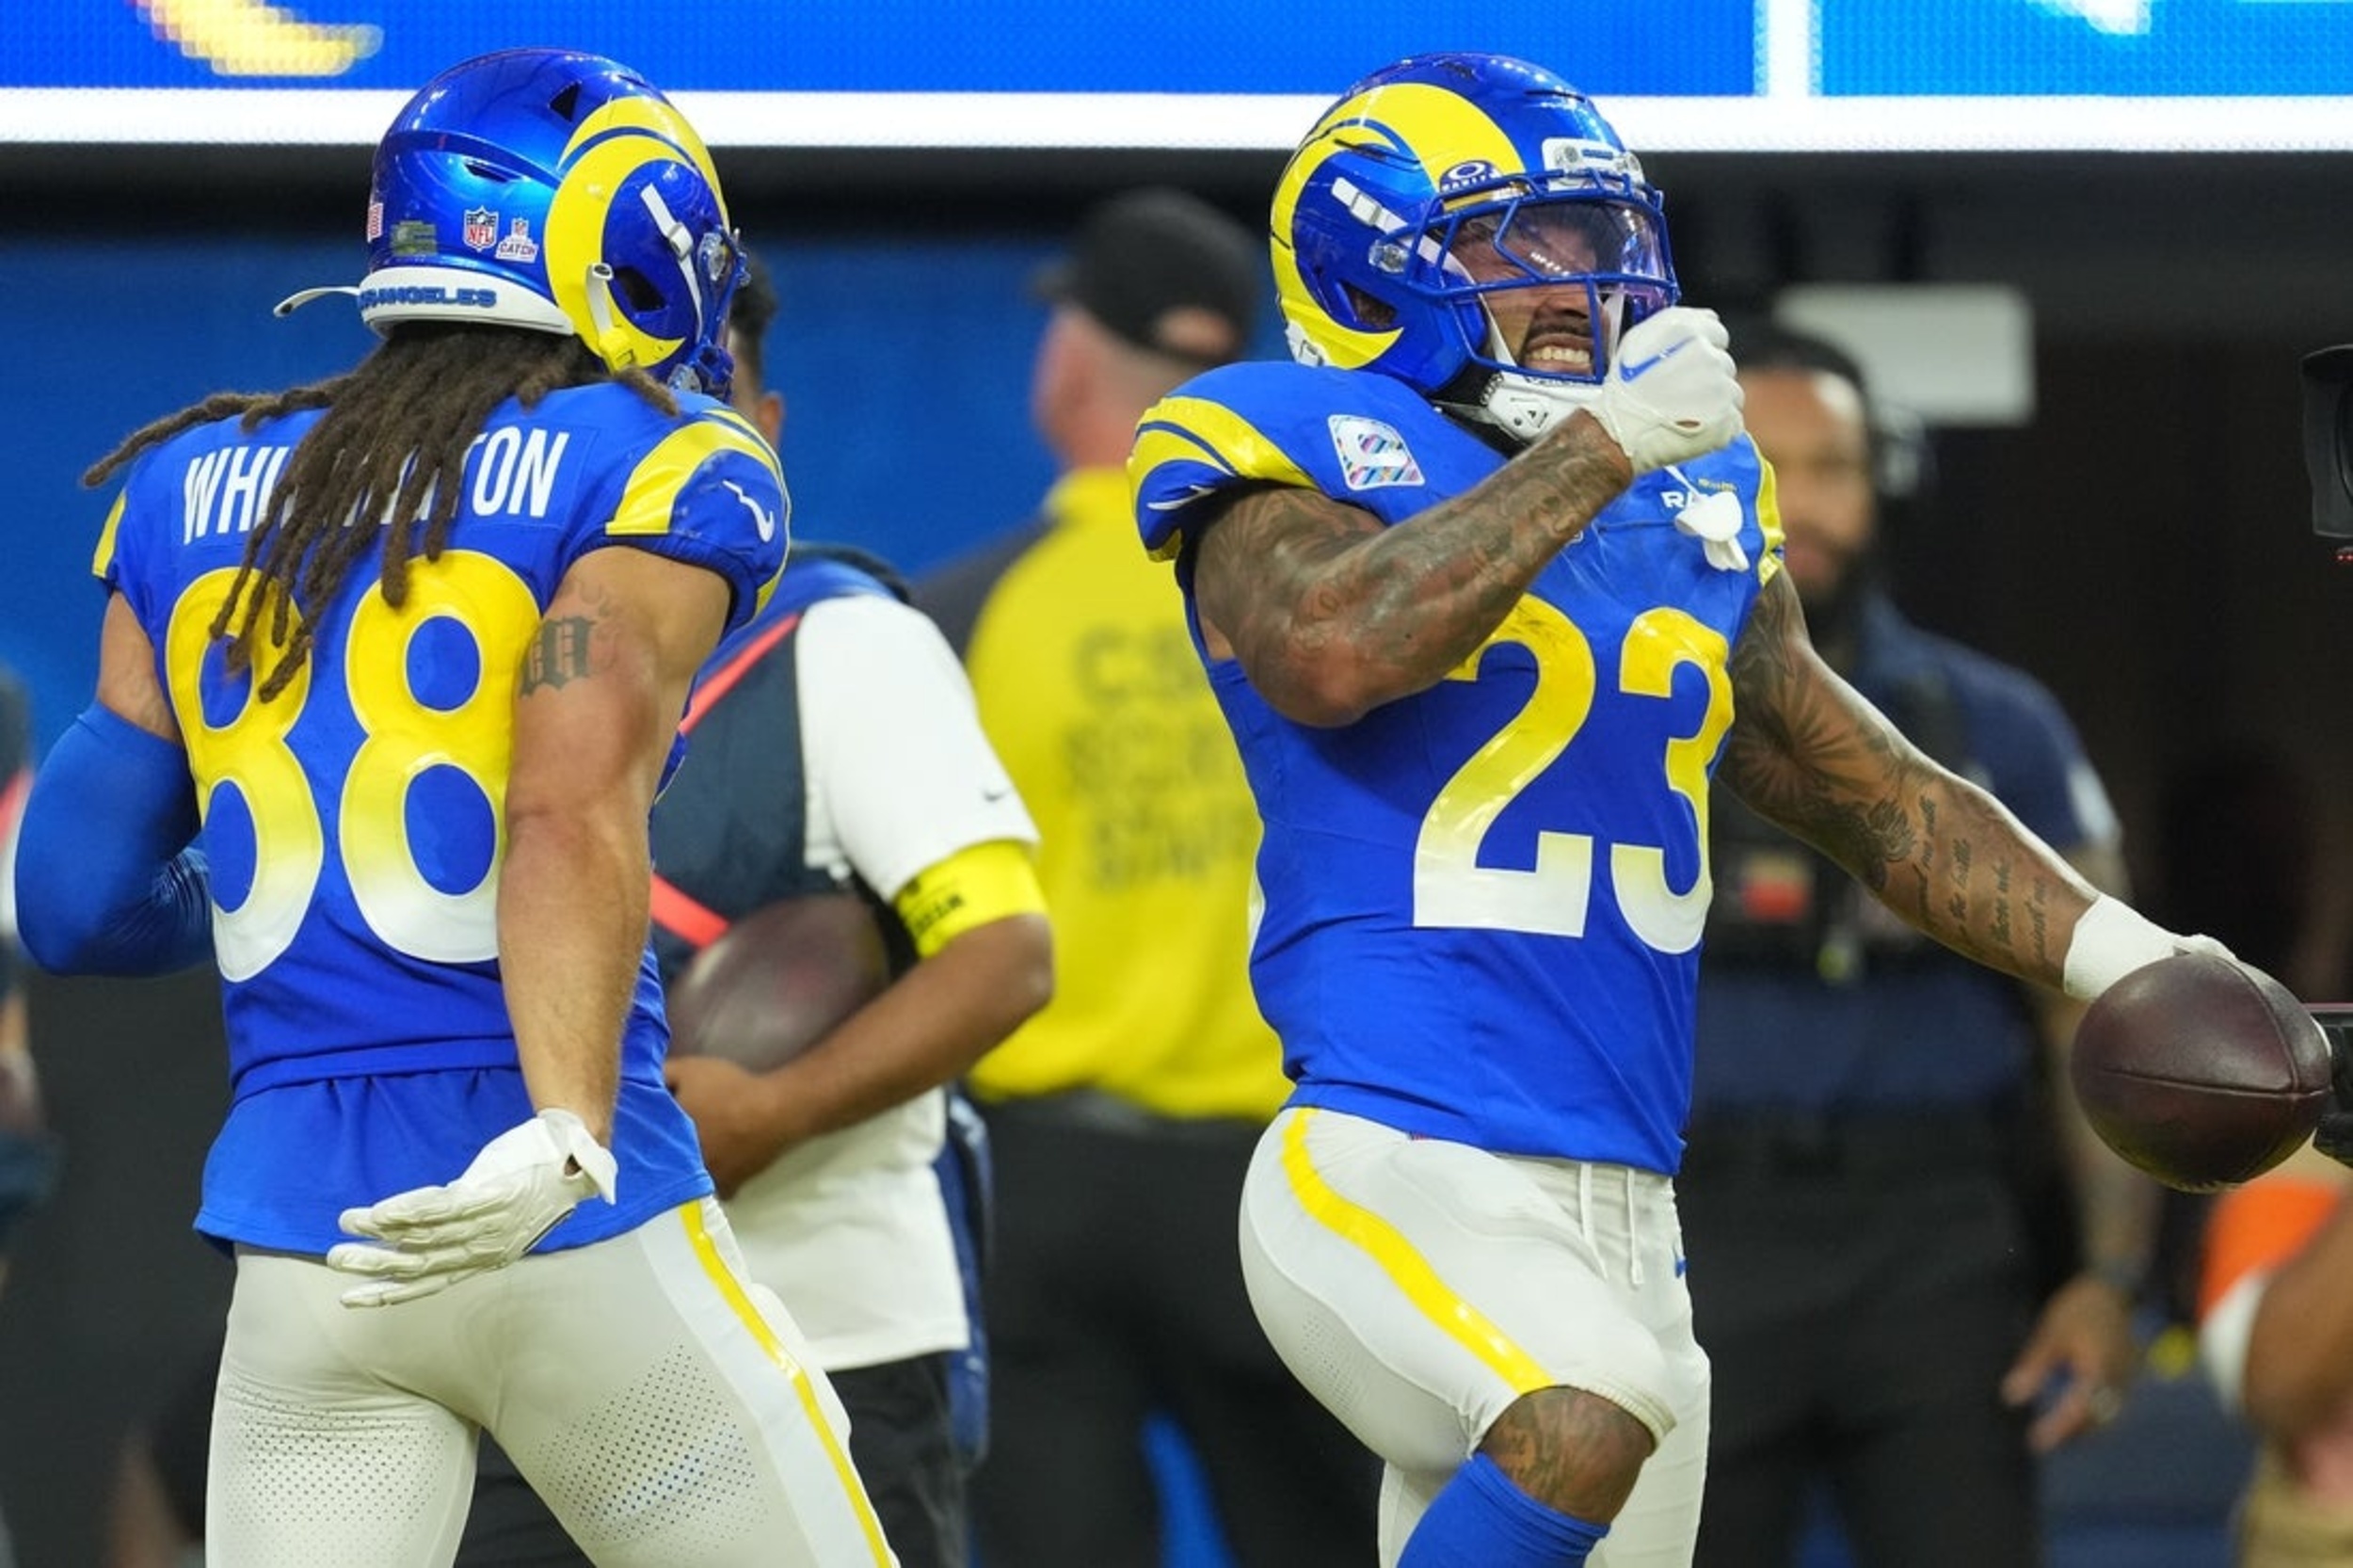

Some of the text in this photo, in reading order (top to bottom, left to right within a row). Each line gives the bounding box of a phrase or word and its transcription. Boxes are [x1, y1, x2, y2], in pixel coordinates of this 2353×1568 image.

[467, 225, 494, 246] NFL
[165, 549, 542, 983] 88
[1413, 592, 1736, 954] 23
